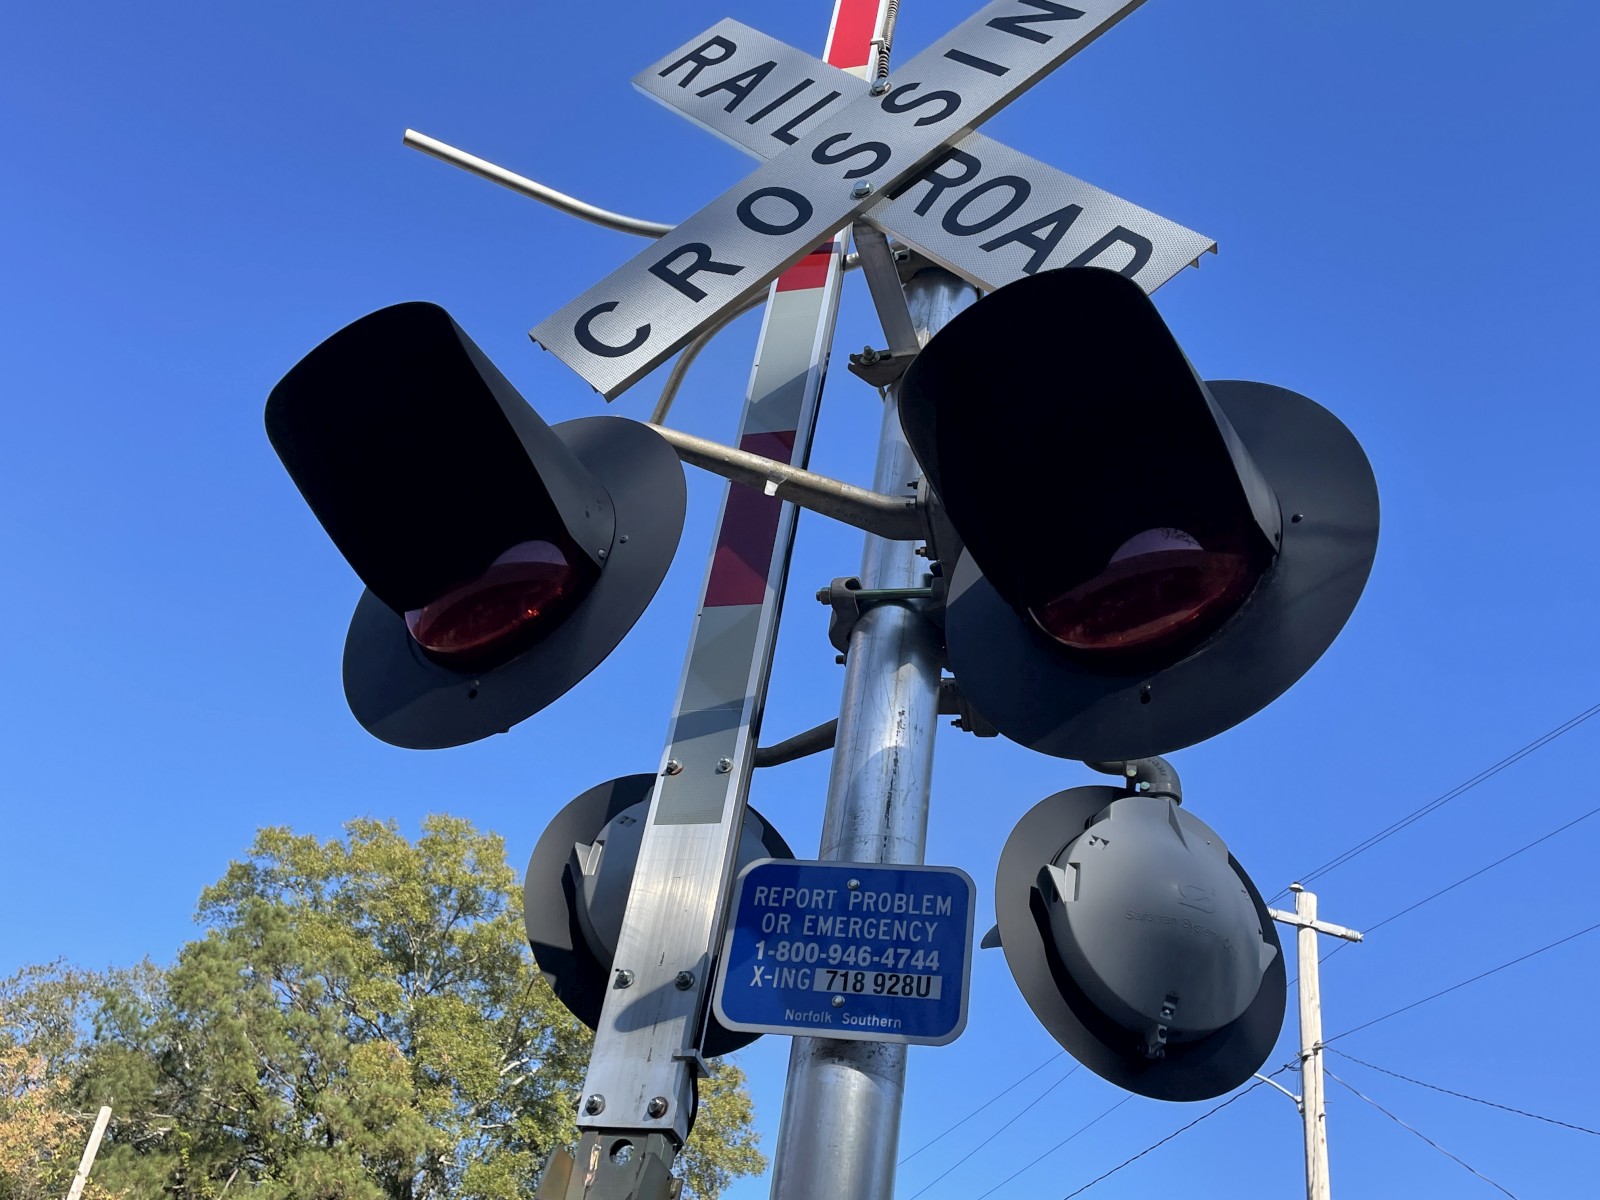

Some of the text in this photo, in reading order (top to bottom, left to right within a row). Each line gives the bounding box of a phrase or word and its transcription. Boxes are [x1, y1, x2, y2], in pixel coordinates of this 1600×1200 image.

[658, 35, 1153, 279] RAIL ROAD
[574, 0, 1087, 357] CROSSIN
[754, 887, 952, 916] REPORT PROBLEM
[762, 913, 939, 942] OR EMERGENCY
[755, 940, 940, 971] 1-800-946-4744
[750, 966, 931, 998] X-ING 718 928U
[785, 1009, 902, 1028] Norfolk Southern
